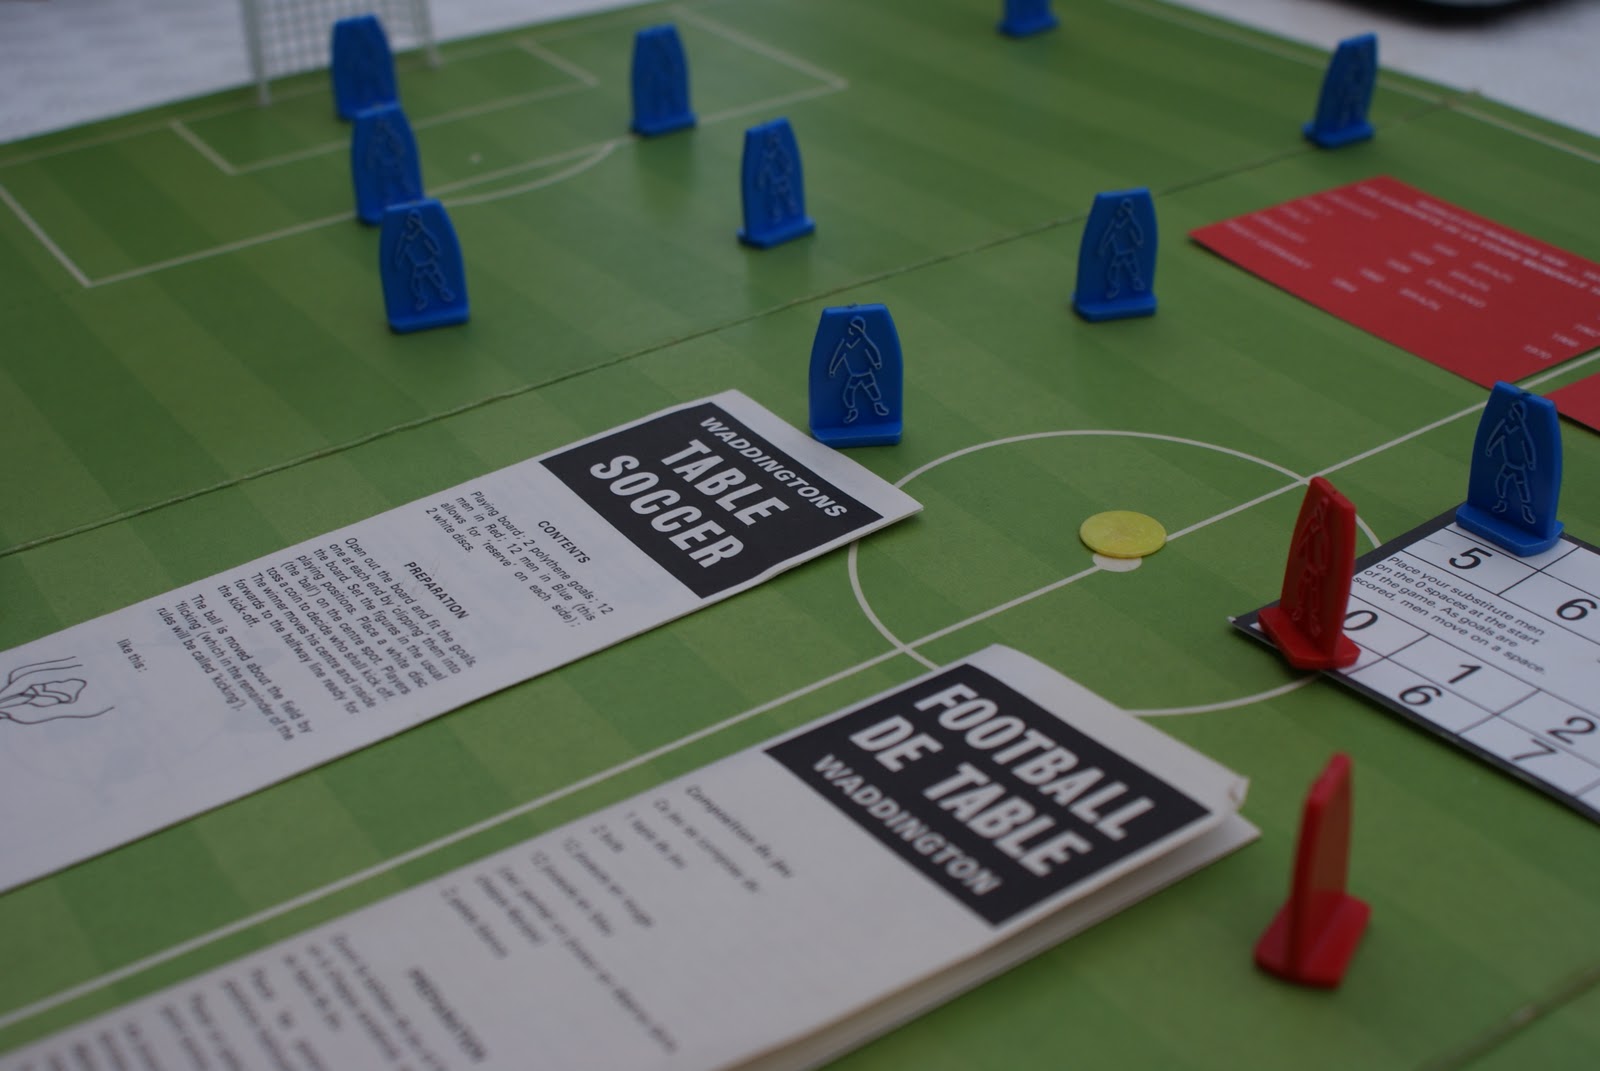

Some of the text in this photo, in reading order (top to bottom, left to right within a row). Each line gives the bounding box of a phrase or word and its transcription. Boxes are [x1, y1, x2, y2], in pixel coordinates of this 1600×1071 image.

[660, 438, 790, 526] TABLE
[700, 416, 847, 518] WADDINGTONS
[432, 514, 455, 533] white
[440, 502, 466, 524] allows
[466, 526, 481, 537] for
[514, 571, 528, 582] on
[529, 584, 551, 602] each
[455, 497, 474, 512] men
[473, 514, 485, 522] in
[506, 543, 523, 555] 12
[519, 556, 540, 572] men
[538, 573, 551, 582] in
[551, 583, 573, 601] Blue
[470, 491, 499, 517] Playing
[528, 547, 571, 580] polythene
[597, 603, 614, 615] 12
[537, 520, 591, 563] CONTENTS
[590, 455, 744, 568] SOCCER
[217, 584, 232, 598] the
[345, 537, 367, 557] Open
[364, 557, 381, 570] out
[376, 570, 393, 583] the
[389, 582, 418, 605] board
[411, 605, 433, 620] and
[426, 619, 441, 630] fit
[436, 629, 454, 643] the
[403, 561, 469, 619] PREPARATION
[1387, 557, 1545, 636] Place your substitute men
[1449, 547, 1493, 570] 5
[116, 638, 133, 654] like
[156, 607, 176, 625] rules
[171, 625, 191, 639] will
[182, 638, 196, 650] be
[191, 650, 218, 674] called
[233, 578, 360, 714] forwards to the halfway line ready for
[250, 572, 376, 708] The winner moves his centre and inside
[266, 566, 284, 582] toss
[284, 587, 303, 603] coin
[298, 602, 311, 611] to
[306, 611, 333, 635] decide
[329, 635, 348, 652] who
[343, 652, 368, 670] shall
[361, 669, 381, 687] kick
[295, 555, 325, 580] playing
[355, 615, 379, 637] Place
[385, 646, 410, 669] white
[407, 671, 428, 688] disc
[313, 548, 329, 561] the
[346, 583, 365, 597] Set
[359, 597, 376, 610] the
[372, 610, 401, 636] figures
[396, 636, 409, 645] in
[406, 644, 423, 659] the
[420, 659, 448, 681] usual
[316, 597, 330, 609] on
[326, 608, 342, 622] the
[338, 622, 365, 646] centre
[380, 665, 411, 695] Players
[329, 543, 346, 557] one
[341, 557, 355, 565] at
[349, 565, 371, 582] each
[366, 582, 387, 596] end
[379, 594, 395, 606] by
[422, 637, 445, 658] them
[441, 658, 461, 674] into
[1343, 609, 1378, 631] 0
[1376, 564, 1393, 573] on
[1393, 571, 1414, 583] the
[1424, 587, 1468, 610] spaces
[1468, 609, 1484, 618] at
[1484, 616, 1507, 629] the
[1506, 628, 1540, 645] start
[1378, 576, 1400, 588] the
[1439, 607, 1459, 618] As
[1458, 617, 1495, 636] goals
[1495, 635, 1518, 647] are
[1399, 599, 1429, 616] men
[1430, 615, 1468, 635] move
[1470, 634, 1489, 646] on
[1556, 598, 1597, 621] 6
[191, 593, 313, 733] The ball is moved about the field by
[219, 656, 232, 666] in
[226, 665, 243, 680] the
[237, 679, 274, 716] remainder
[269, 716, 285, 725] of
[277, 725, 294, 741] the
[1399, 685, 1442, 706] 6
[1448, 663, 1481, 684] 1
[914, 683, 1155, 841] FOOTBALL
[1512, 738, 1558, 761] 7
[1547, 716, 1596, 745] 2
[813, 754, 1001, 895] WADDINGTON
[850, 715, 1091, 876] DE TABLE
